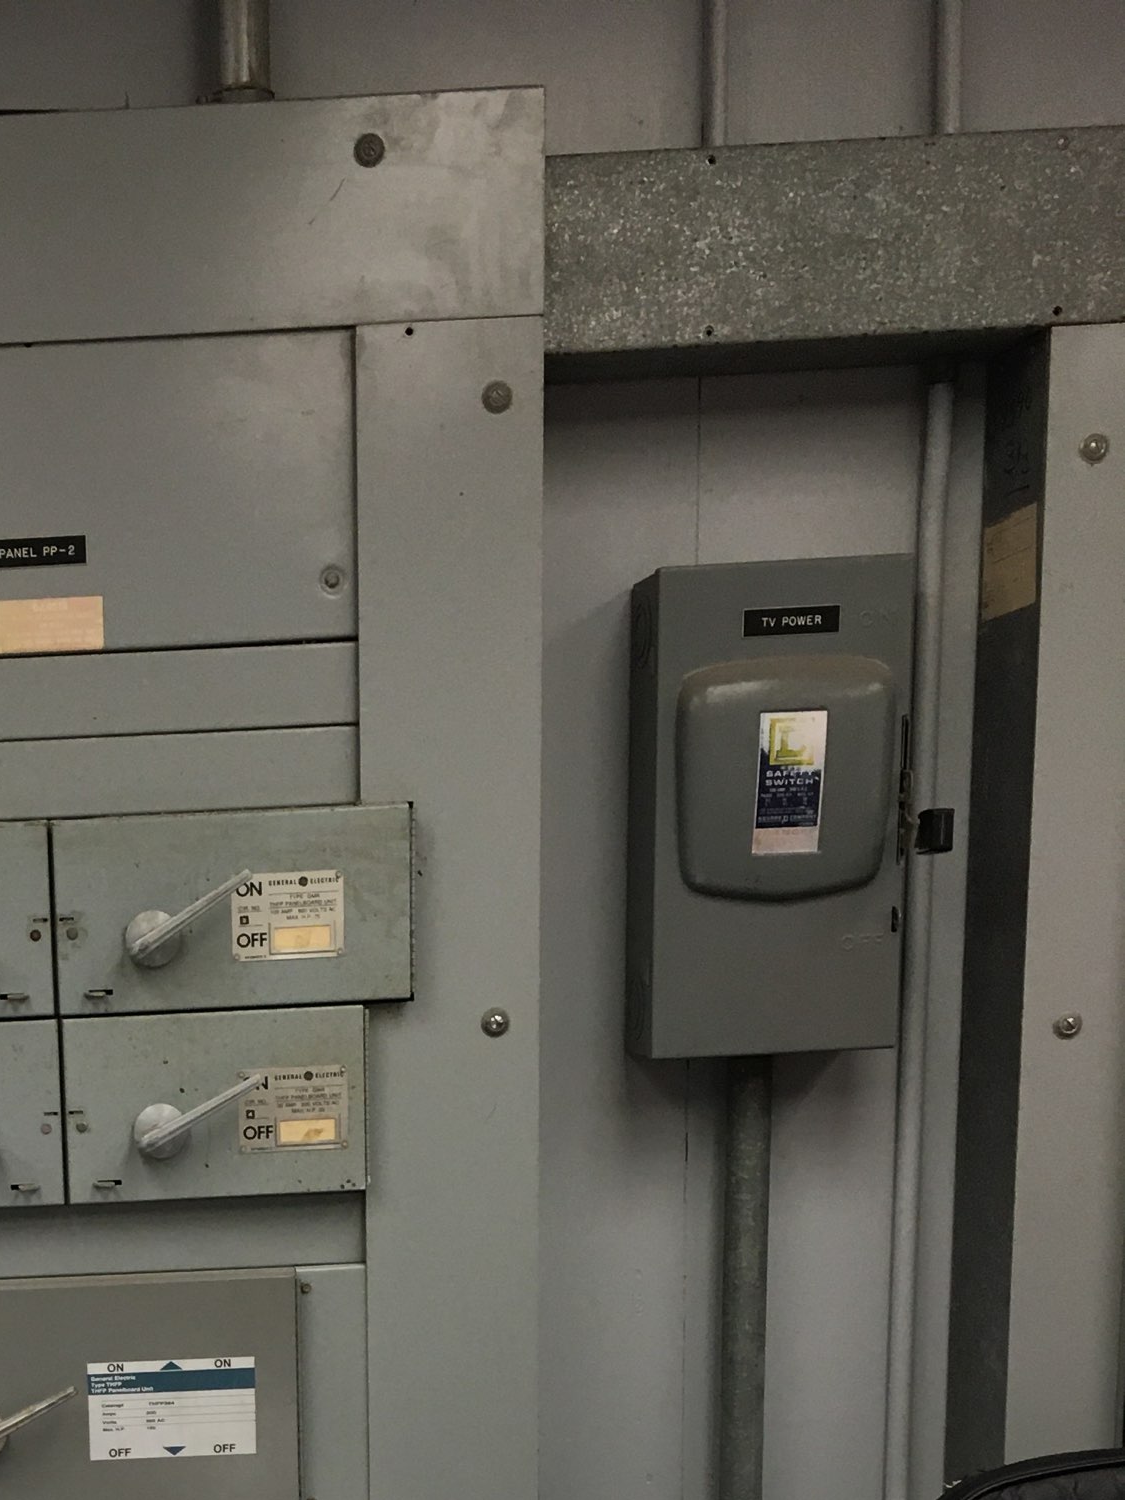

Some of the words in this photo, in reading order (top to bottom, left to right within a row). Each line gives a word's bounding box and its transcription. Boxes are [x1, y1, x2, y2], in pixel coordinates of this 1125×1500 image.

[42, 545, 76, 556] PP-2
[761, 617, 777, 628] TV
[781, 614, 822, 627] POWER
[765, 778, 814, 786] SWITCH
[236, 882, 262, 897] ON
[268, 879, 296, 887] GENERAL
[237, 932, 268, 948] OFF
[315, 1071, 345, 1079] ELECTRIC
[243, 1125, 274, 1140] OFF
[107, 1363, 124, 1373] ON
[214, 1359, 232, 1368] ON
[109, 1447, 132, 1458] OFF
[213, 1443, 236, 1454] OFF
